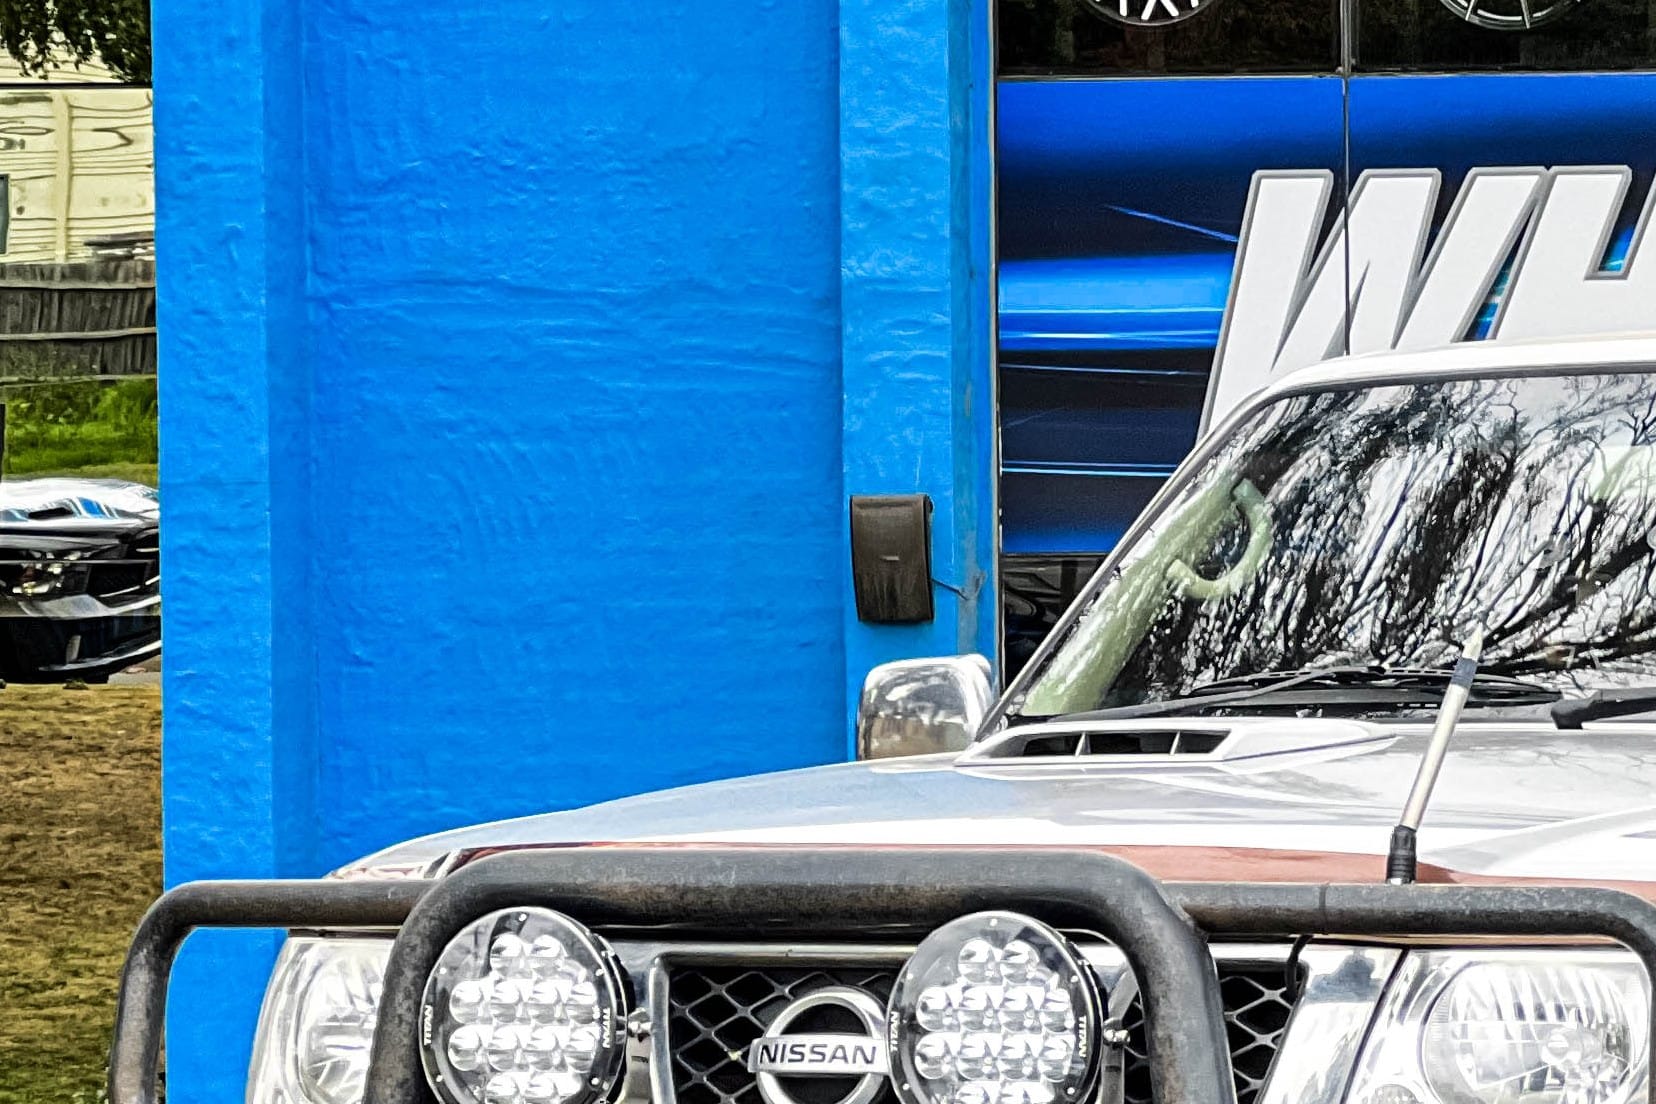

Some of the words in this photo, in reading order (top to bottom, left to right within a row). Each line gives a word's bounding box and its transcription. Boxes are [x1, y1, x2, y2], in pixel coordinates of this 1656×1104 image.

[422, 1004, 435, 1047] TITAN
[601, 1007, 612, 1049] TITAN
[889, 1010, 900, 1053] TITAN
[1078, 1015, 1088, 1059] TITAN
[759, 1043, 877, 1065] NISSAN
